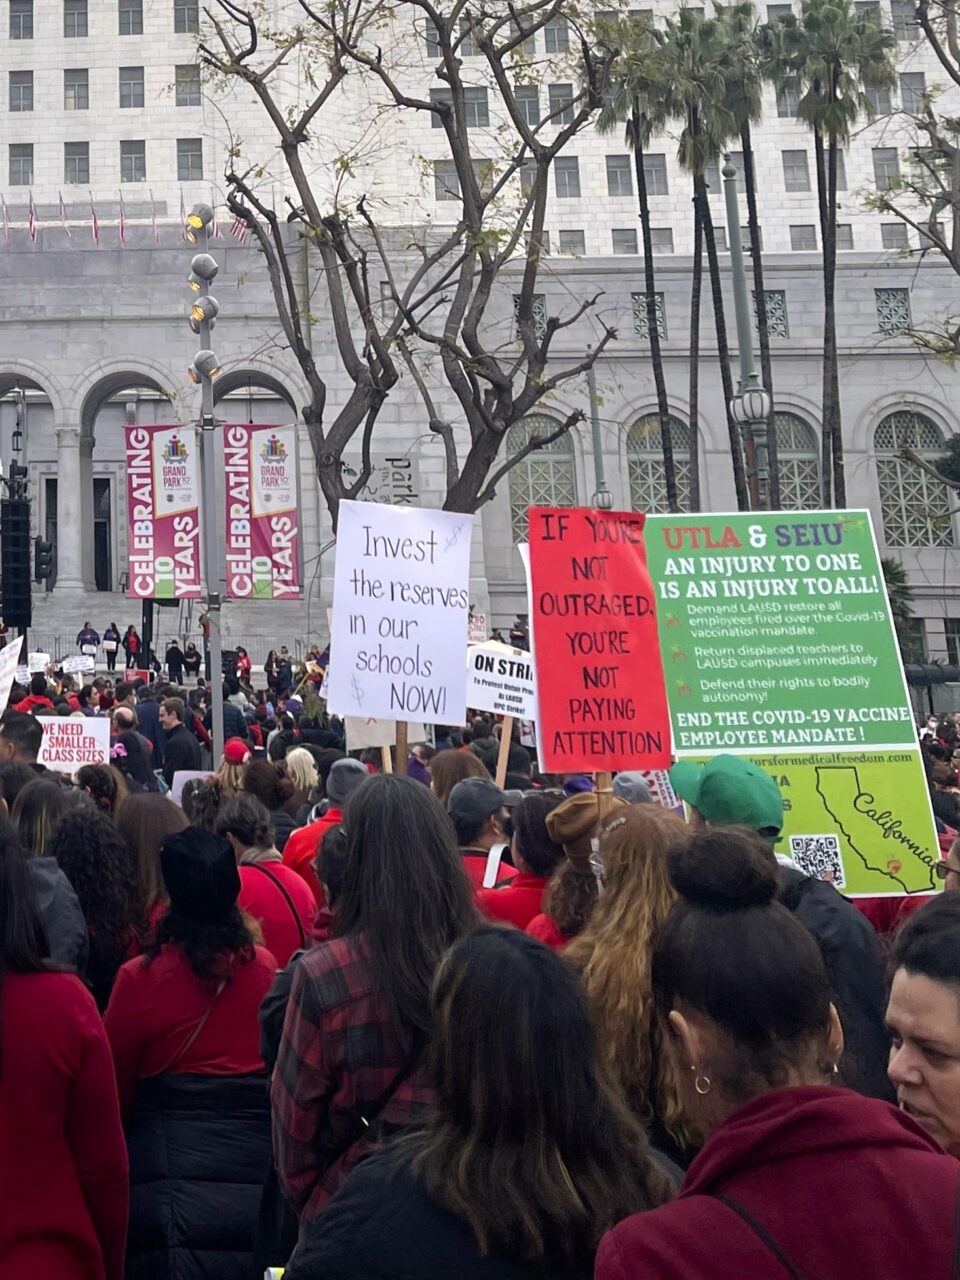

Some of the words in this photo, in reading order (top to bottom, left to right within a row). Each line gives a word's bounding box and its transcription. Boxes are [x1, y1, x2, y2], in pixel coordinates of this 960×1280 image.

[162, 465, 187, 477] GRAND
[163, 477, 182, 487] PARK
[260, 465, 285, 477] GRAND
[261, 477, 281, 487] PARK
[126, 428, 154, 596] CELEBRATING
[224, 426, 251, 596] CELEBRATING
[541, 513, 570, 541] IF
[585, 515, 641, 544] YOU'RE
[662, 526, 742, 550] UTLA
[748, 525, 768, 548] &
[775, 523, 842, 547] SEIU
[174, 516, 201, 597] YEARS
[271, 516, 300, 597] YEARS
[362, 526, 438, 564] Invest
[572, 557, 609, 581] NOT
[664, 557, 695, 576] AN
[700, 556, 777, 577] INJURY
[781, 555, 810, 572] TO
[816, 553, 862, 571] ONE
[350, 568, 385, 599] the
[390, 581, 469, 610] reserves
[659, 581, 680, 599] IS
[686, 580, 722, 598] AN
[724, 579, 802, 600] INJURY
[687, 602, 738, 615] Demand
[741, 602, 782, 613] LAUSD
[784, 601, 826, 612] restore
[828, 600, 842, 610] all
[689, 614, 751, 628] employees
[755, 613, 783, 624] fired
[785, 614, 812, 624] over
[813, 613, 833, 623] the
[836, 610, 885, 622] Covid-19
[349, 614, 366, 635] in
[378, 616, 419, 639] our
[691, 626, 759, 638] vaccination
[761, 625, 818, 636] mandate.
[566, 631, 631, 656] YOU'RE
[695, 646, 736, 657] Return
[738, 644, 794, 656] displaced
[796, 643, 847, 654] teachers
[849, 644, 864, 653] to
[356, 643, 433, 678] schools
[474, 654, 495, 673] ON
[498, 659, 533, 682] STRI
[697, 658, 738, 669] LAUSD
[741, 657, 801, 669] campuses
[804, 654, 878, 667] immediately
[582, 666, 619, 689] NOT
[700, 679, 745, 690] Defend
[747, 677, 776, 688] their
[779, 677, 815, 690] rights
[818, 677, 833, 687] to
[835, 676, 870, 688] bodily
[390, 681, 447, 716] NOW!
[702, 691, 768, 704] autonomy!
[569, 697, 636, 724] PAYING
[677, 712, 713, 727] END
[714, 711, 749, 726] THE
[753, 708, 831, 725] COVID-19
[834, 707, 910, 722] VACCINE
[57, 723, 83, 736] NEED
[680, 731, 768, 746] EMPLOYEE
[772, 727, 857, 744] MANDATE
[48, 736, 96, 749] SMALLER
[552, 731, 663, 756] ATTENTION
[42, 749, 74, 762] CLASS
[76, 750, 105, 765] SIZES
[854, 792, 935, 867] California
